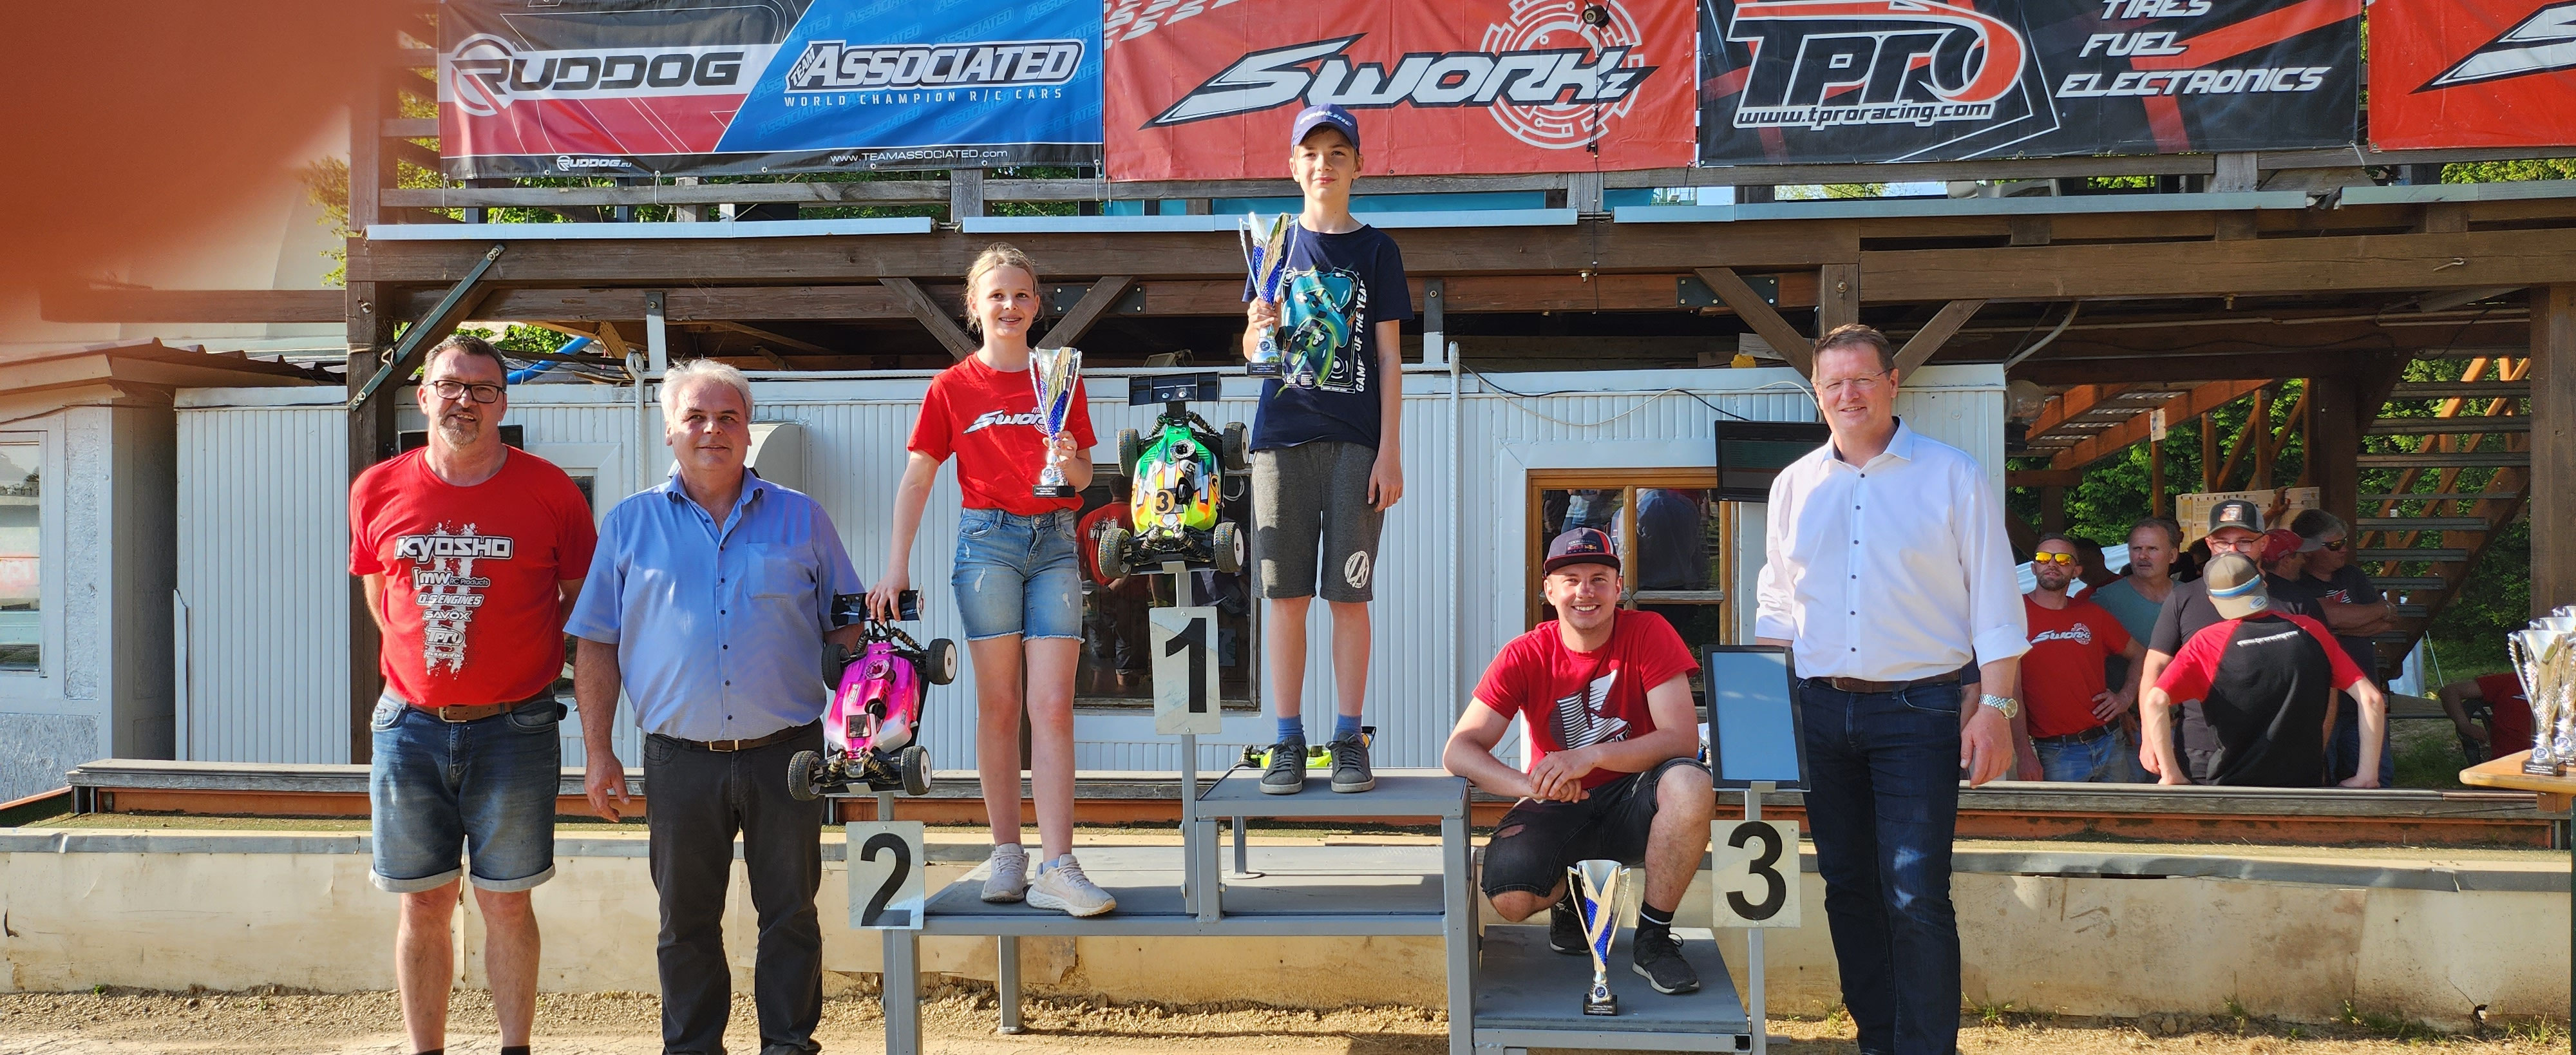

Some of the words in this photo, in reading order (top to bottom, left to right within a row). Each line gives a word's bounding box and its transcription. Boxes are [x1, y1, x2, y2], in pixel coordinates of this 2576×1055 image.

[2101, 0, 2213, 19] TIRES
[2079, 31, 2187, 58] FUEL
[451, 49, 744, 107] RUDDOG
[790, 48, 815, 87] TEAM
[796, 44, 1079, 87] ASSOCIATED
[2054, 66, 2332, 99] ELECTRONICS
[784, 95, 846, 107] WORLD
[860, 91, 955, 105] CHAMPION
[970, 89, 1001, 102] R/C
[1016, 88, 1061, 100] CARS
[1738, 103, 1992, 127] www.tproracing.com
[829, 149, 1008, 162] www.TEAMASSOCIATED.com
[1356, 312, 1364, 334] THE
[1155, 491, 1169, 512] 3
[396, 537, 510, 562] KYOSHO
[1165, 617, 1208, 714] 1
[860, 832, 912, 927] 2
[1725, 820, 1786, 920] 3
